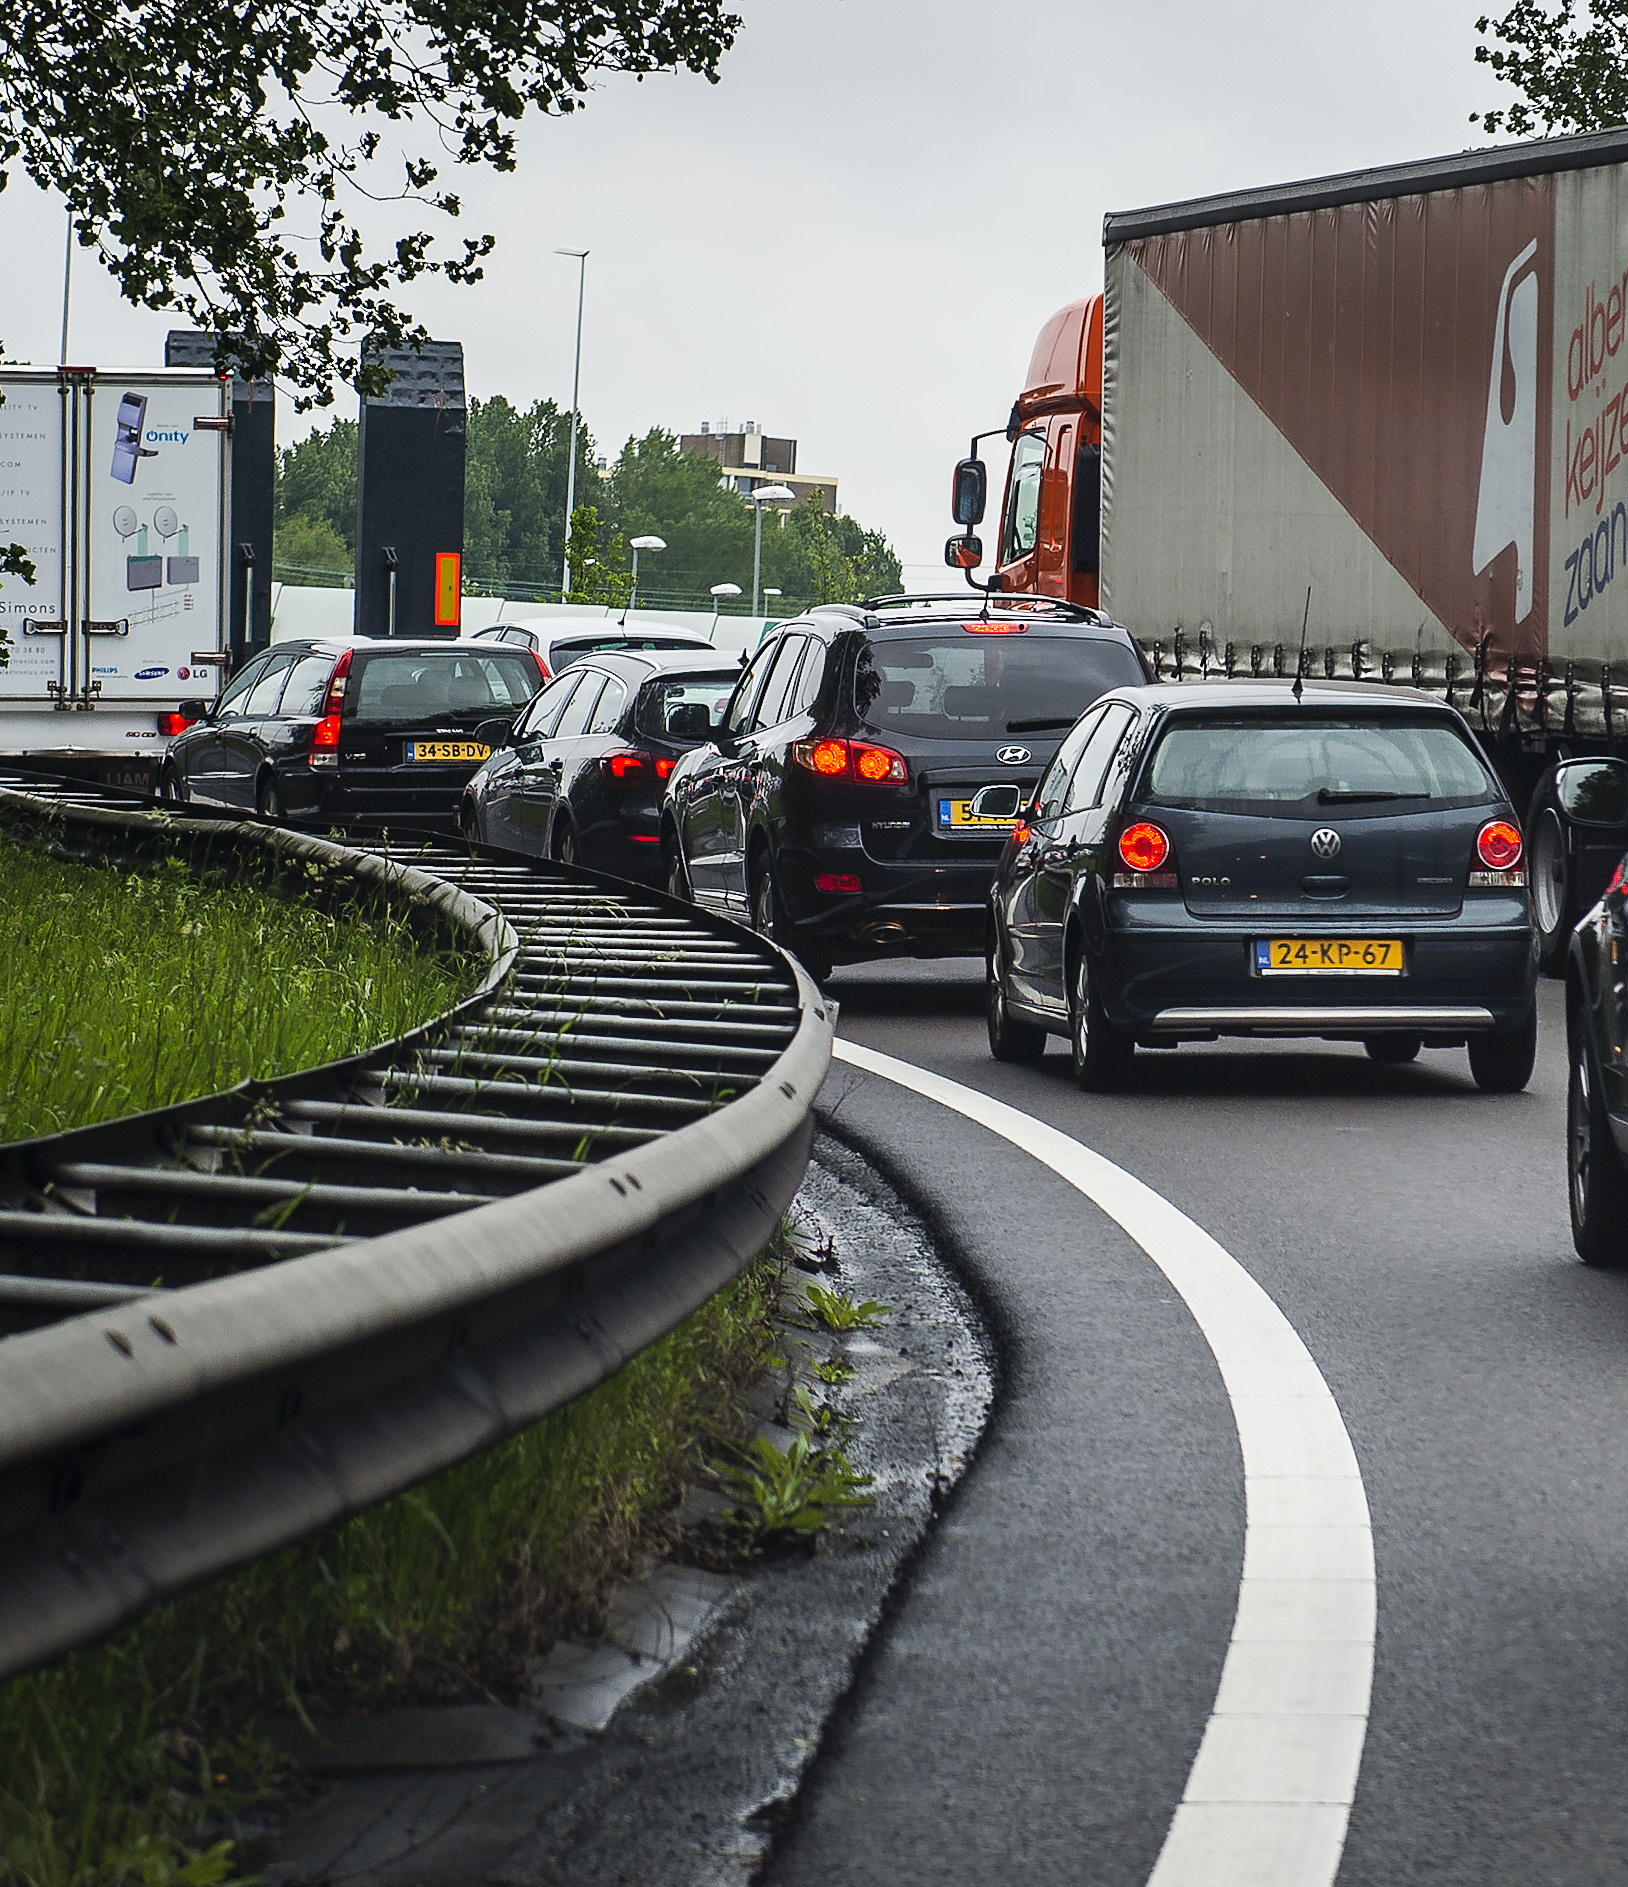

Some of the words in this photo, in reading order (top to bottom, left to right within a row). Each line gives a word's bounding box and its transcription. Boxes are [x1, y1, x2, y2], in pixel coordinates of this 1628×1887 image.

[146, 429, 190, 445] Onity
[0, 601, 56, 614] Simons
[193, 669, 208, 679] LG
[418, 744, 487, 758] 34-SB-DV
[1191, 876, 1231, 886] POLO
[1277, 943, 1391, 965] 24-KP-67
